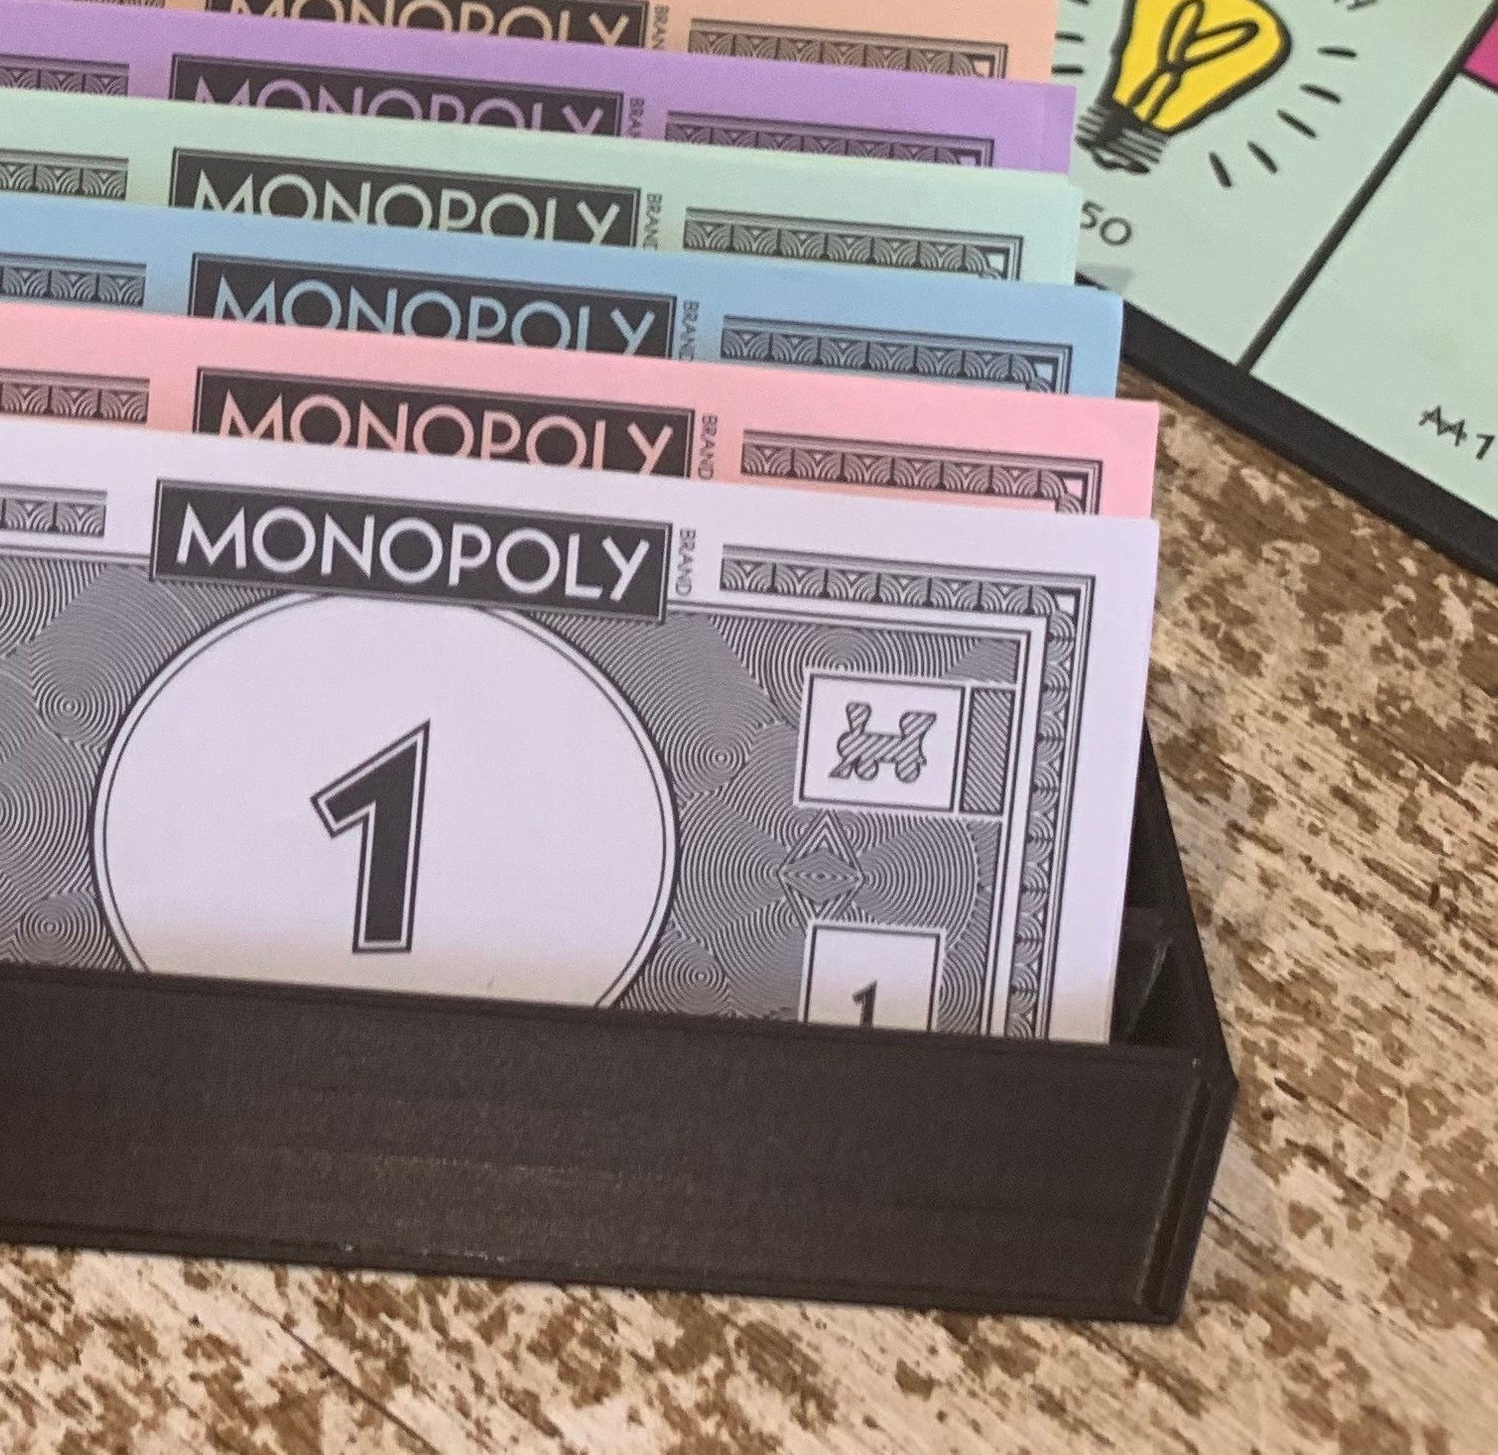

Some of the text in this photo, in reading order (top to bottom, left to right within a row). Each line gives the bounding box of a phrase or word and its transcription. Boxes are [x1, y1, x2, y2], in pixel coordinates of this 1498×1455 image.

[193, 170, 620, 247] MONOPOLY
[214, 275, 656, 357] MONOPOLY
[218, 390, 673, 477] MONOPOLY
[177, 502, 650, 601] MONOPOLY
[675, 528, 697, 598] BRAND
[310, 718, 430, 953] 1
